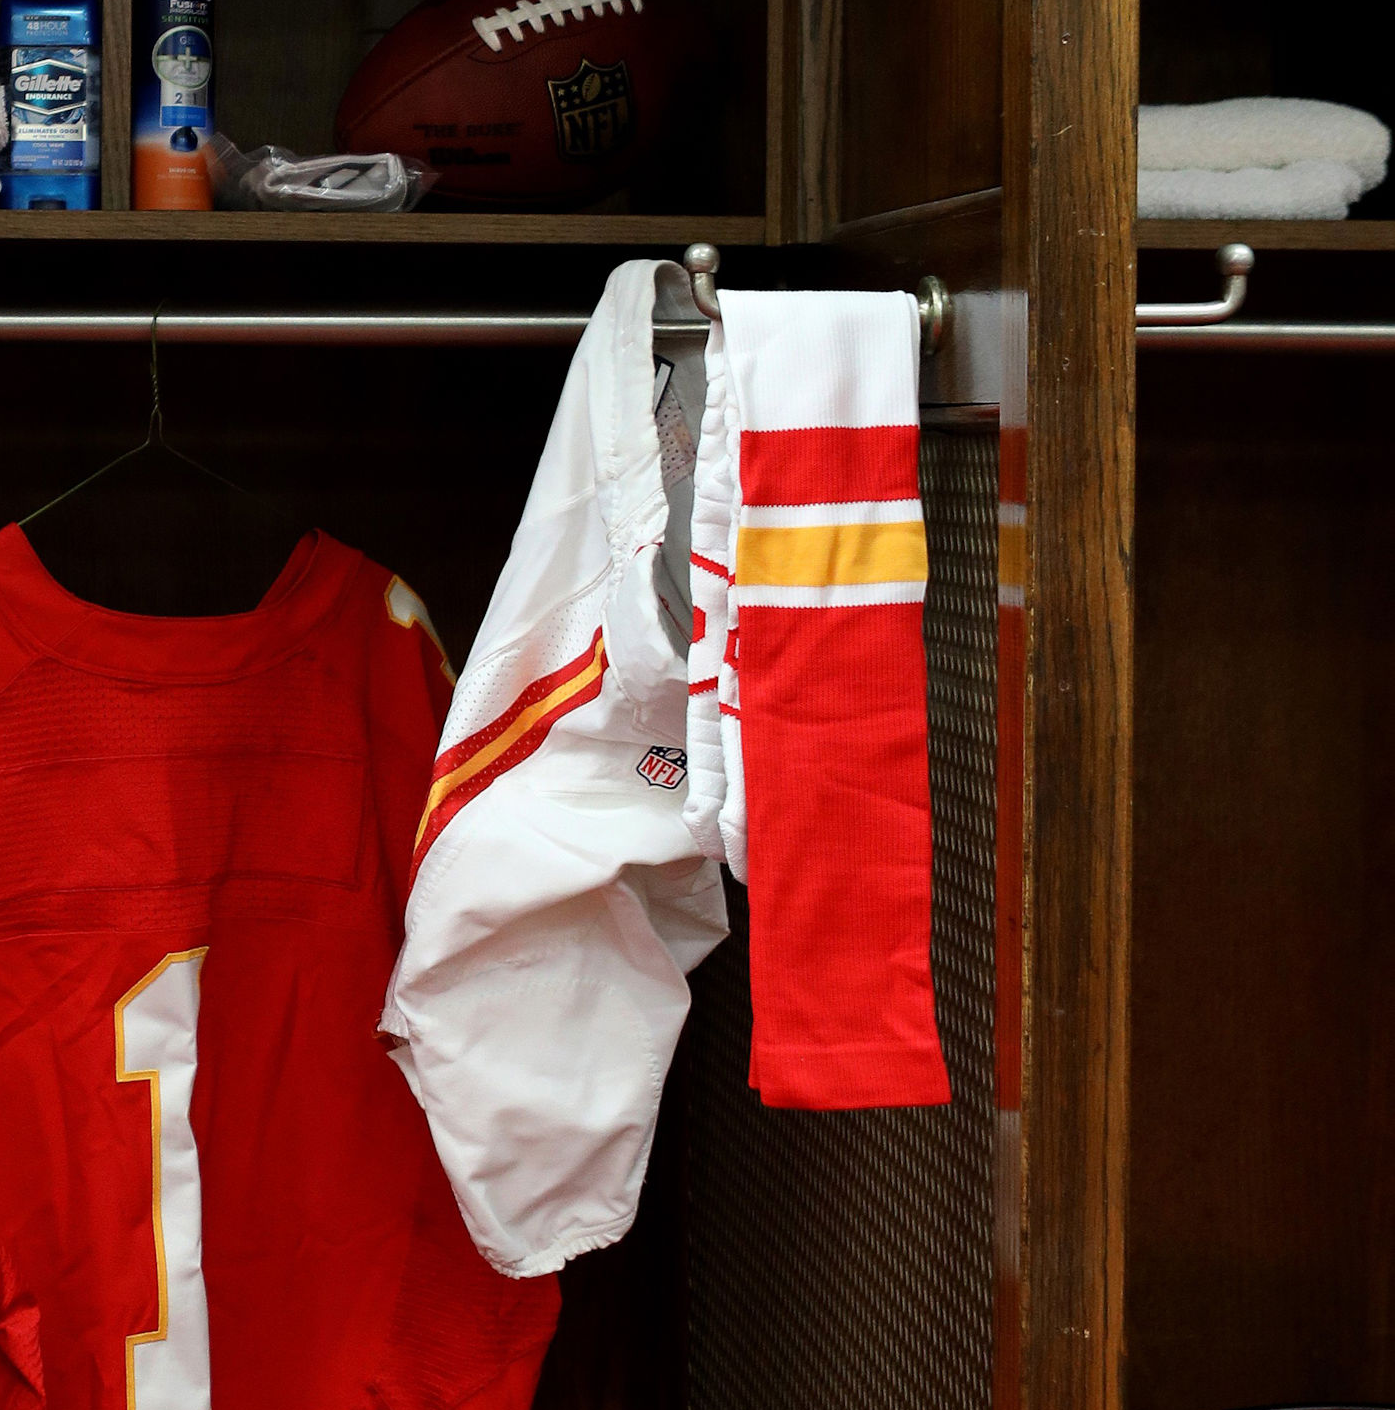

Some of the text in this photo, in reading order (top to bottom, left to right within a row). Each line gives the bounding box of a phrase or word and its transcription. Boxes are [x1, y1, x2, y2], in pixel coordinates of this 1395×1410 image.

[14, 74, 84, 92] Gillette
[24, 92, 73, 101] ENDURANCE
[175, 92, 184, 104] 2
[640, 755, 679, 785] NFL
